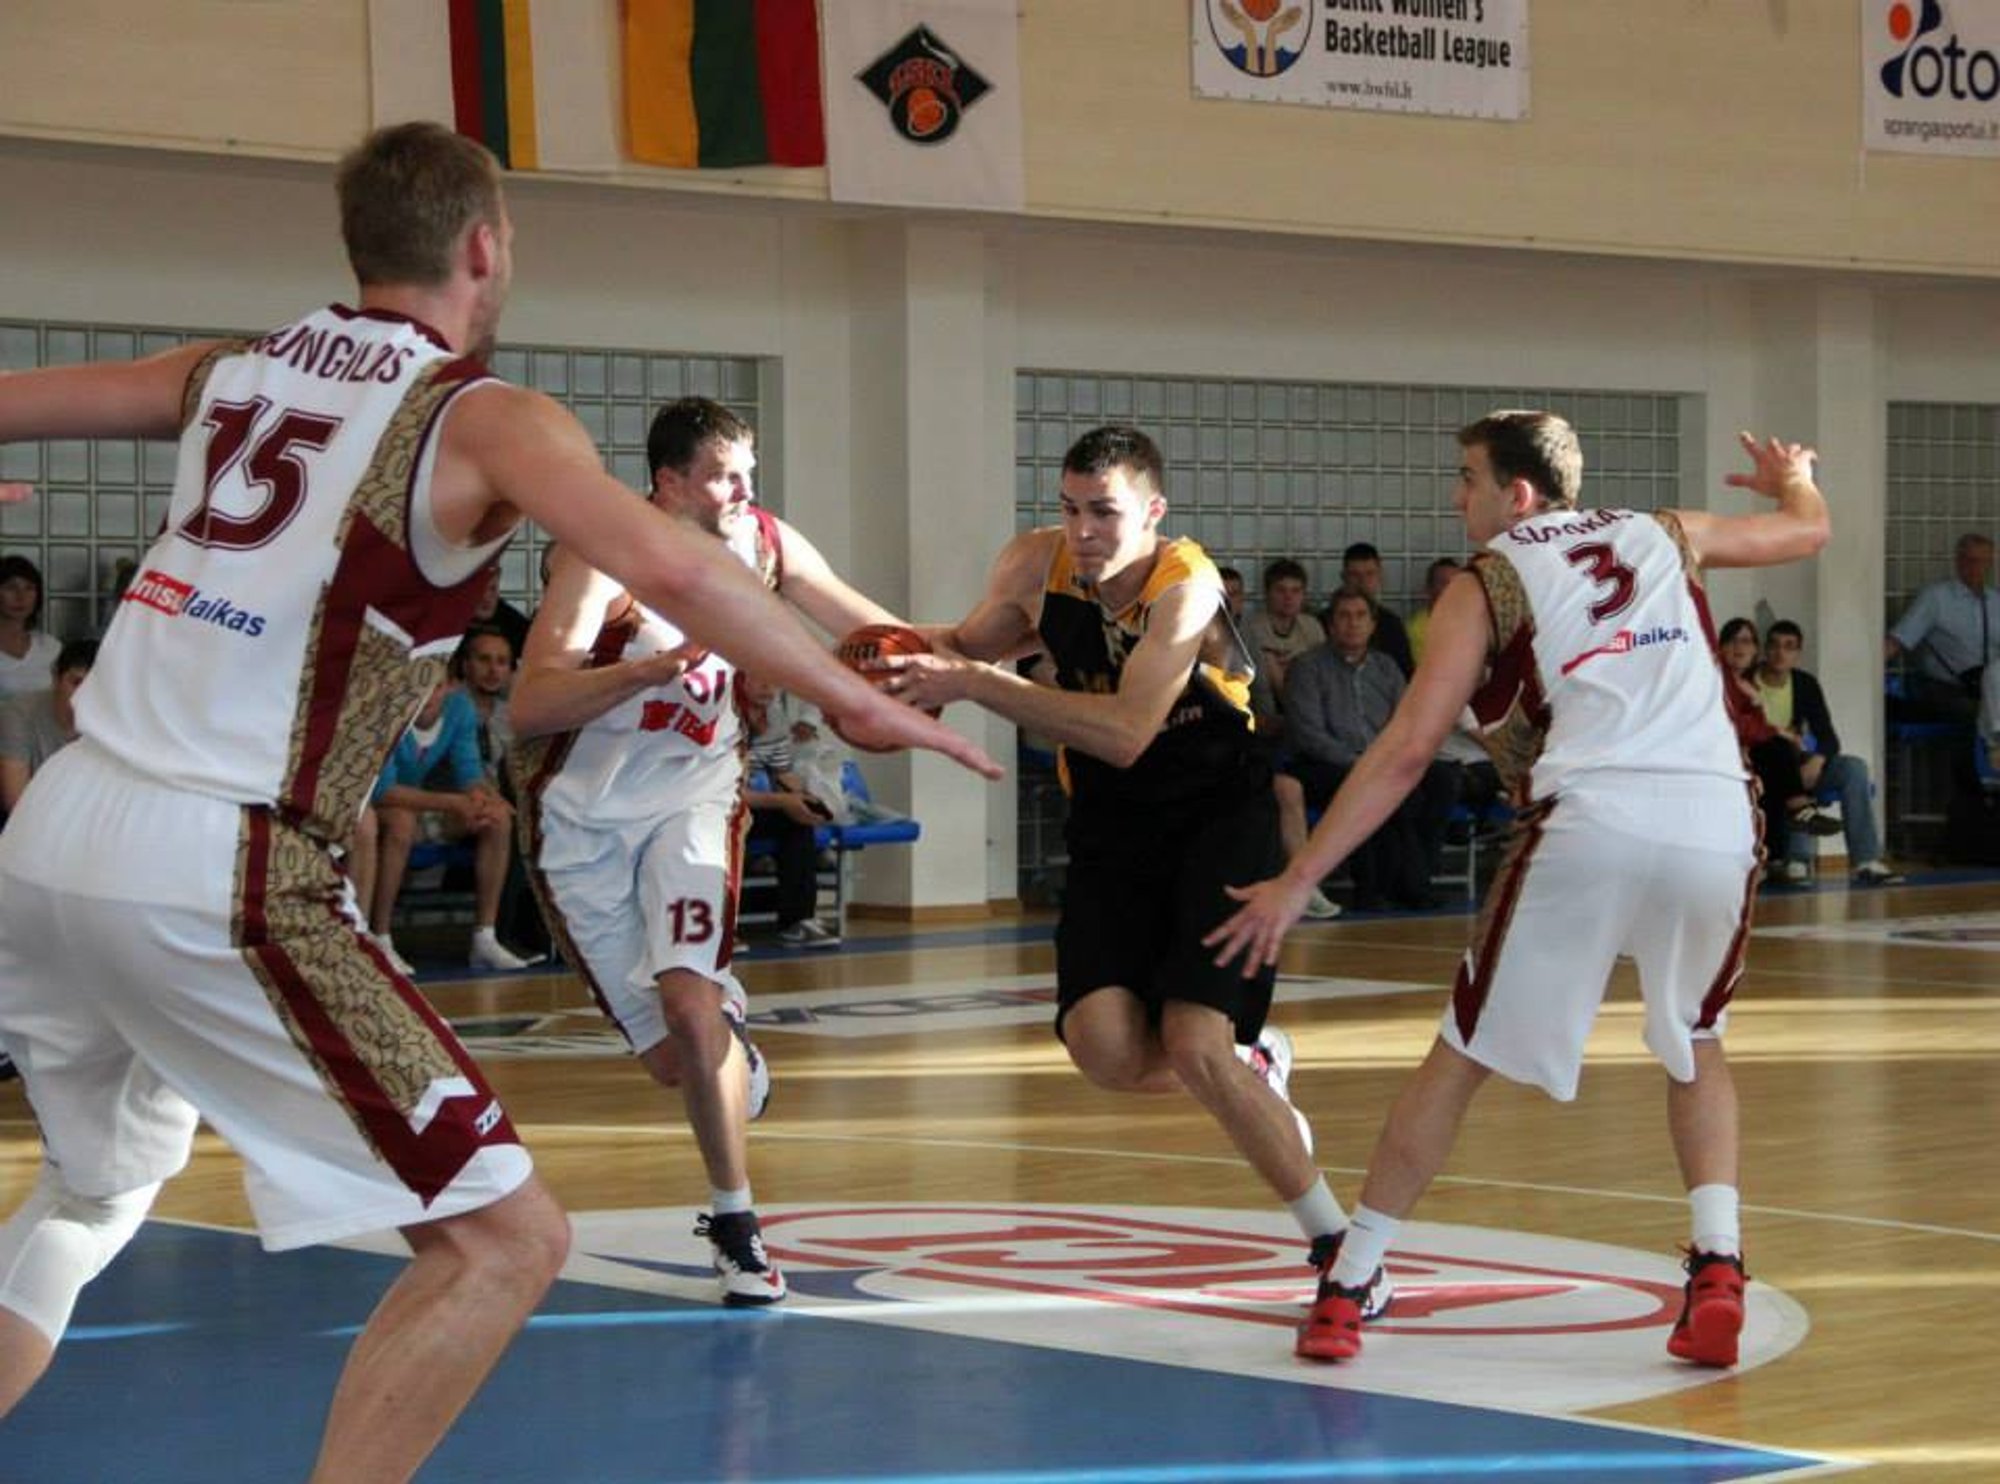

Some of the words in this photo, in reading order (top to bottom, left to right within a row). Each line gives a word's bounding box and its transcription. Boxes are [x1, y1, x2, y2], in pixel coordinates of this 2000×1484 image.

[1325, 19, 1436, 60] Basketball
[1443, 29, 1511, 67] League
[174, 394, 346, 552] 15
[1562, 540, 1640, 626] 3
[666, 896, 715, 945] 13
